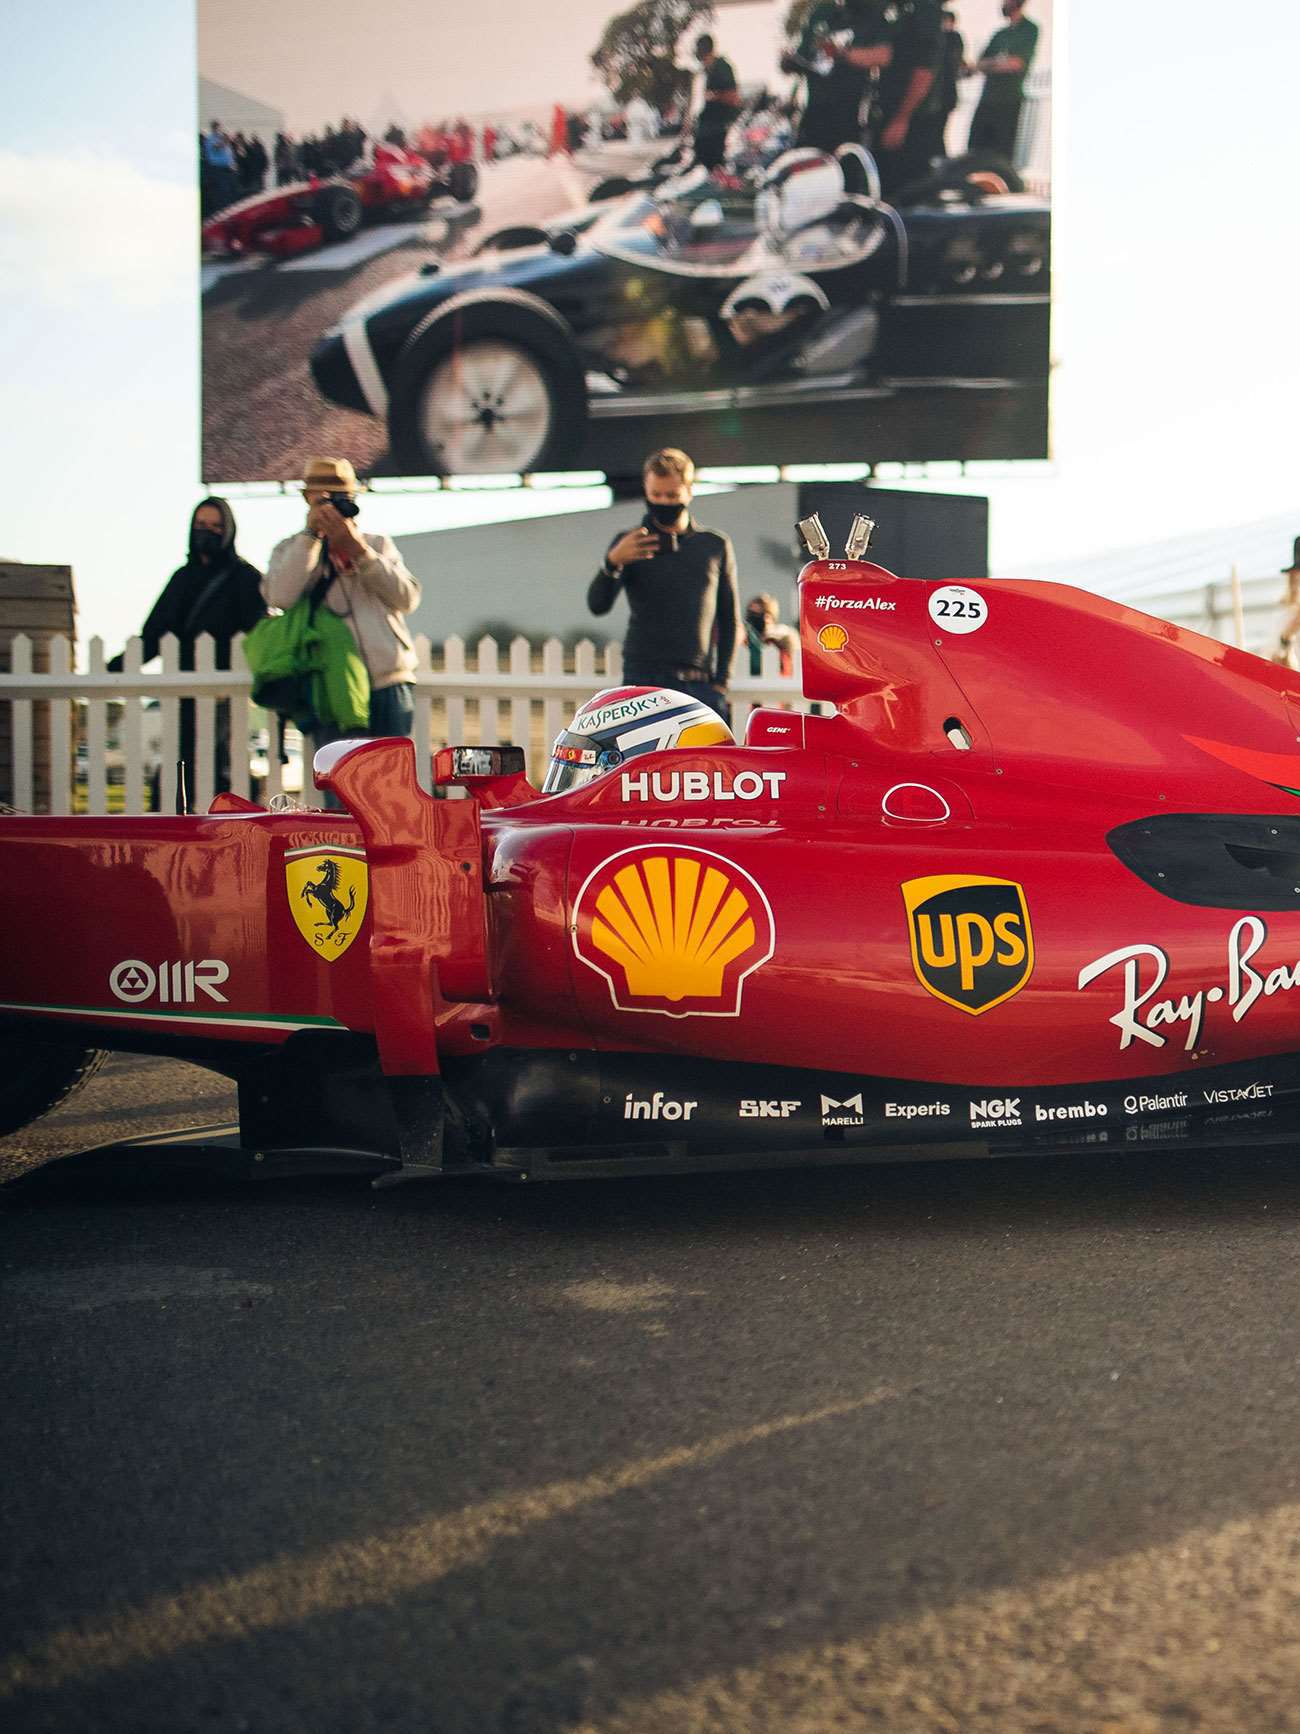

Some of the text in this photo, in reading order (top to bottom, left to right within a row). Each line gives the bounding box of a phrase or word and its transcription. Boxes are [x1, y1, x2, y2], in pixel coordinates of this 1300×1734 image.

[815, 595, 897, 611] #forzaAlex
[936, 600, 981, 618] 225
[577, 697, 661, 731] KASPERSKY
[621, 771, 786, 802] HUBLOT
[624, 1092, 698, 1121] infor
[739, 1100, 802, 1118] SKF
[885, 1101, 951, 1119] Experis
[970, 1098, 1021, 1120] NGK
[1035, 1101, 1108, 1121] brembo
[1139, 1092, 1188, 1112] Palantir
[822, 1117, 864, 1126] MARELLI
[971, 1118, 1022, 1128] SPARK PLUGS
